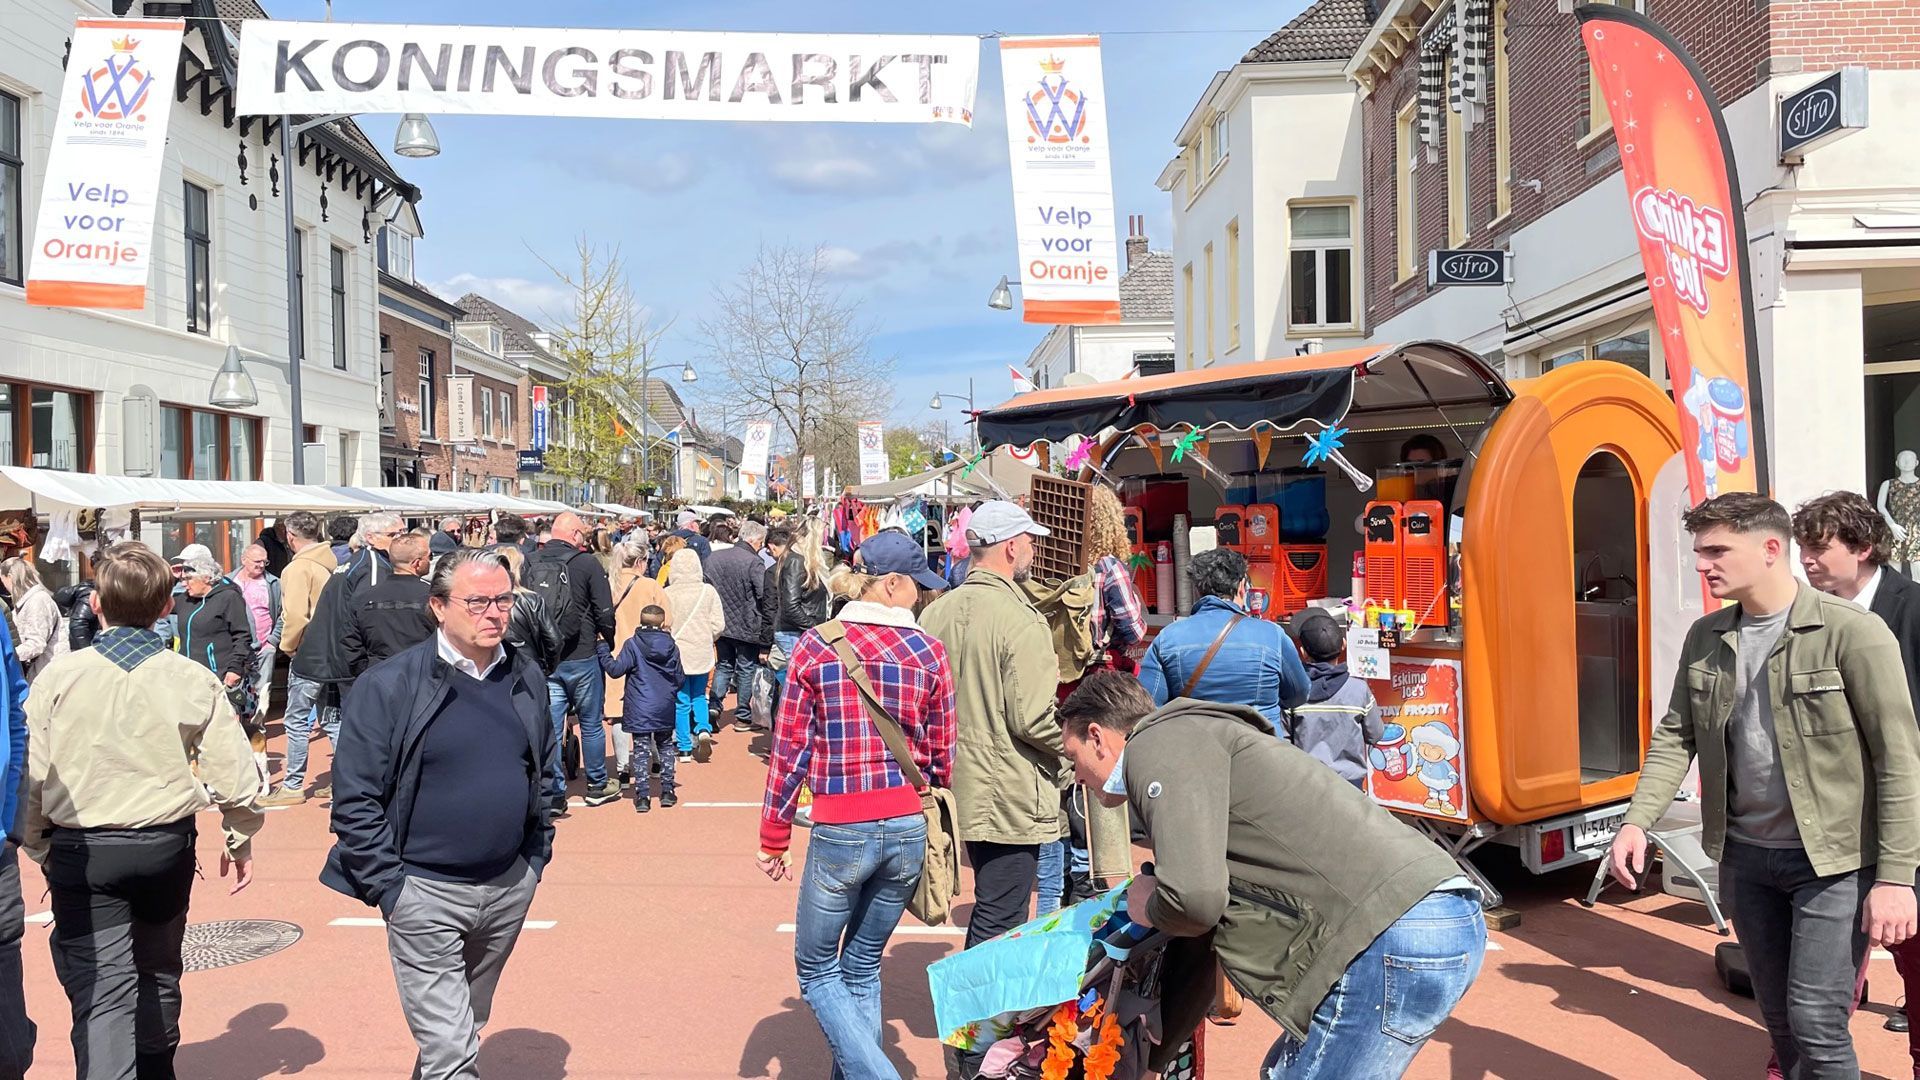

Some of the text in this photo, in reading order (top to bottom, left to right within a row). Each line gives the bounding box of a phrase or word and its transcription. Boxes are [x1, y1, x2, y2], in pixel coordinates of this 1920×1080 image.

[274, 39, 948, 105] KONINGSMARKT
[1793, 95, 1828, 134] sifra
[68, 182, 129, 207] Velp
[64, 213, 125, 232] voor
[1038, 206, 1092, 229] Velp
[43, 238, 138, 266] Oranje
[1041, 236, 1093, 252] voor
[1029, 260, 1108, 284] Oranje
[1449, 255, 1489, 279] sifra
[1392, 671, 1428, 689] Eskimo
[1402, 683, 1425, 699] Joe's
[1380, 703, 1449, 717] TAY FROSTY
